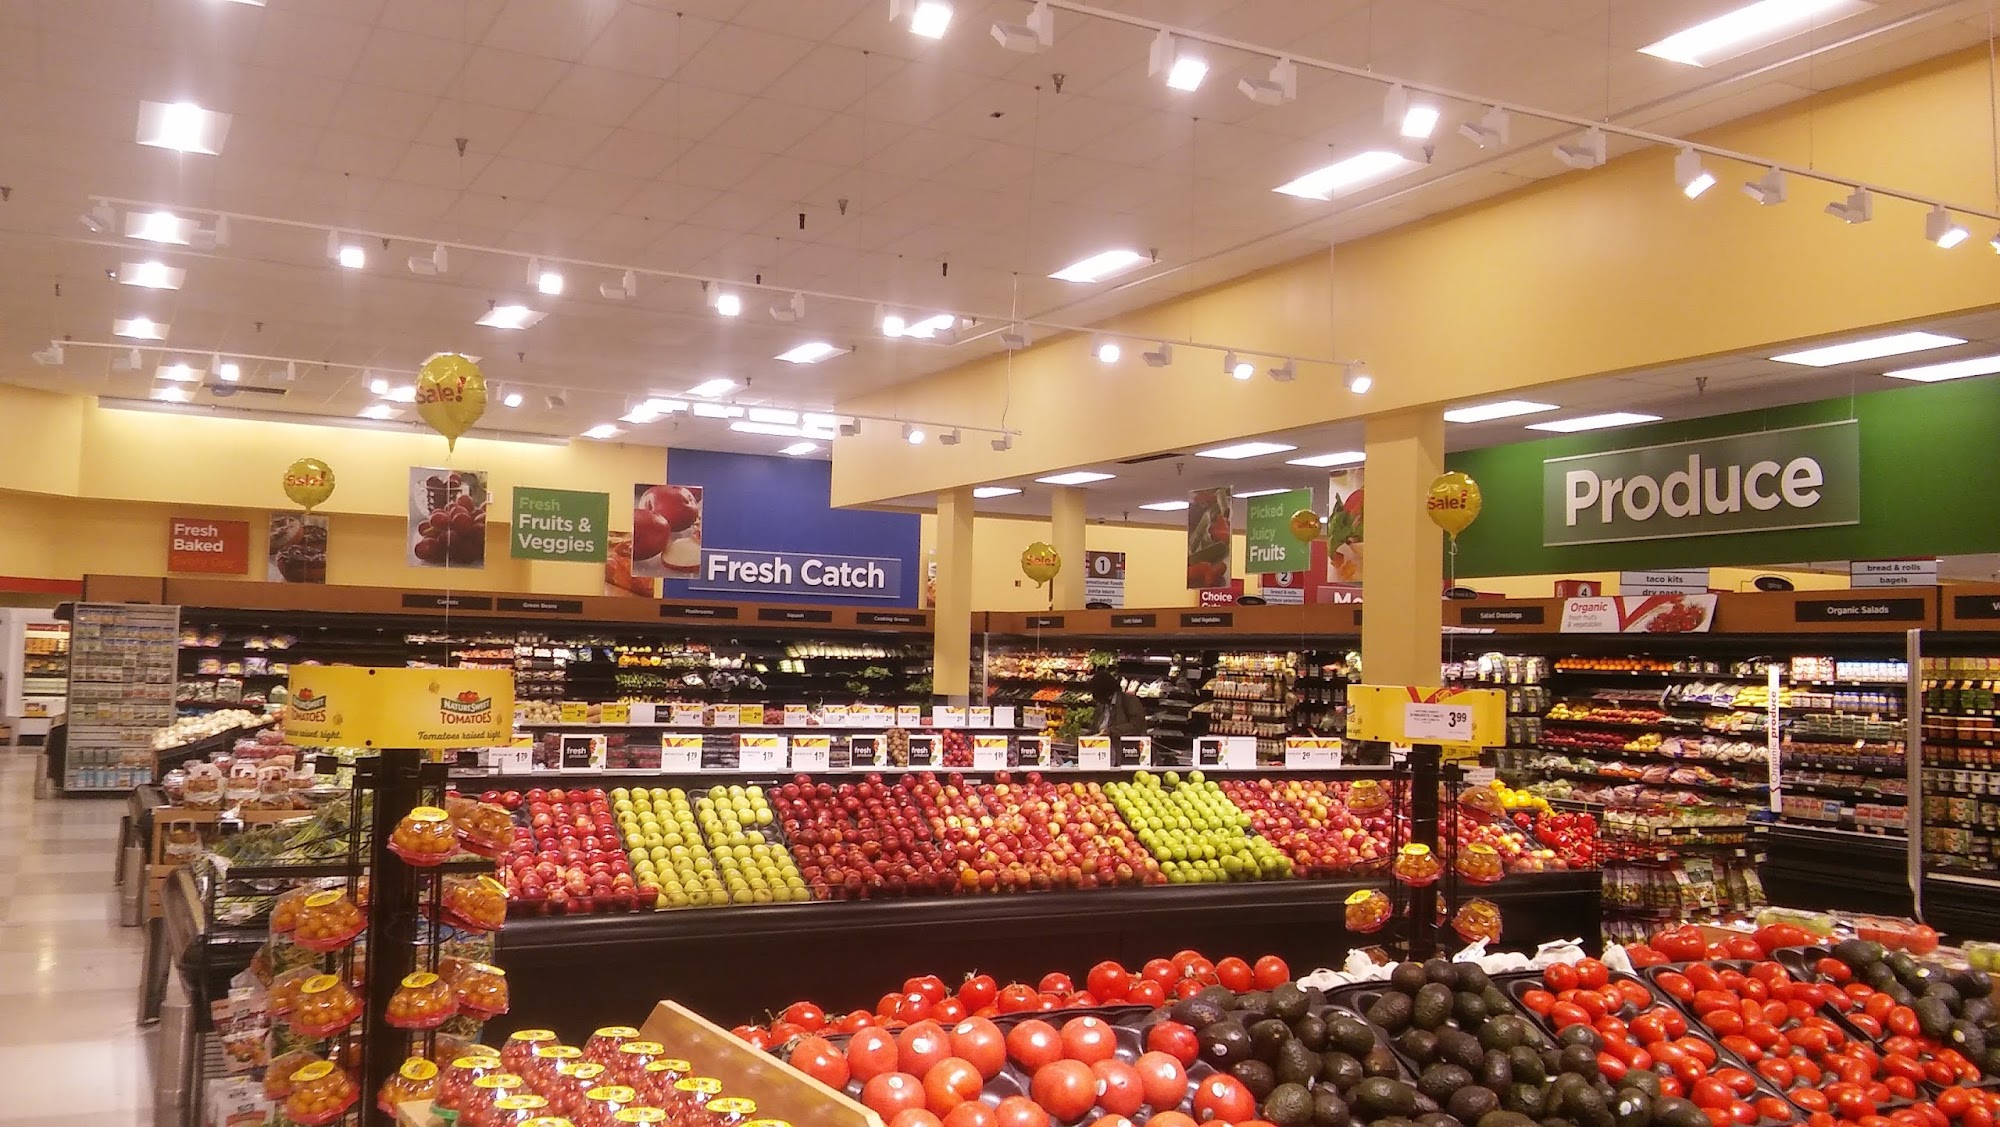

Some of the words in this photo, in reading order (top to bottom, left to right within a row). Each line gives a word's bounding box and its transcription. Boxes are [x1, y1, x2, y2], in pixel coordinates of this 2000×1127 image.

[415, 376, 467, 405] Sale!
[1566, 453, 1824, 527] Produce
[520, 497, 560, 512] Fresh
[1427, 489, 1468, 510] Sale!
[1250, 503, 1283, 519] Picked
[519, 513, 573, 532] Fruits
[578, 517, 592, 533] &
[174, 523, 219, 538] Fresh
[1250, 527, 1276, 542] Juicy
[173, 538, 224, 553] Baked
[518, 533, 595, 554] Veggies
[1249, 543, 1286, 562] Fruits
[707, 553, 793, 586] Fresh
[800, 558, 885, 589] Catch
[1099, 560, 1105, 572] 1
[1867, 563, 1893, 571] bread
[1894, 563, 1900, 571] &
[1901, 563, 1921, 571] rolls
[1281, 572, 1288, 582] 2
[1646, 575, 1665, 583] taco
[1668, 575, 1684, 583] kits
[1879, 576, 1908, 584] bagels
[1201, 591, 1233, 602] Choice
[1581, 588, 1588, 597] 4
[1570, 602, 1608, 613] Organic
[1827, 605, 1859, 616] Organic
[1861, 605, 1889, 615] Salads
[1496, 611, 1523, 620] Dressings
[440, 711, 492, 724] TOMATOES
[1770, 691, 1779, 738] produce
[418, 731, 460, 740] Tomatoes
[462, 731, 485, 739] raised
[566, 747, 587, 755] fresh
[854, 746, 872, 754] fresh
[911, 746, 928, 754] fresh
[1020, 747, 1037, 755] fresh
[1770, 740, 1779, 783] Organic
